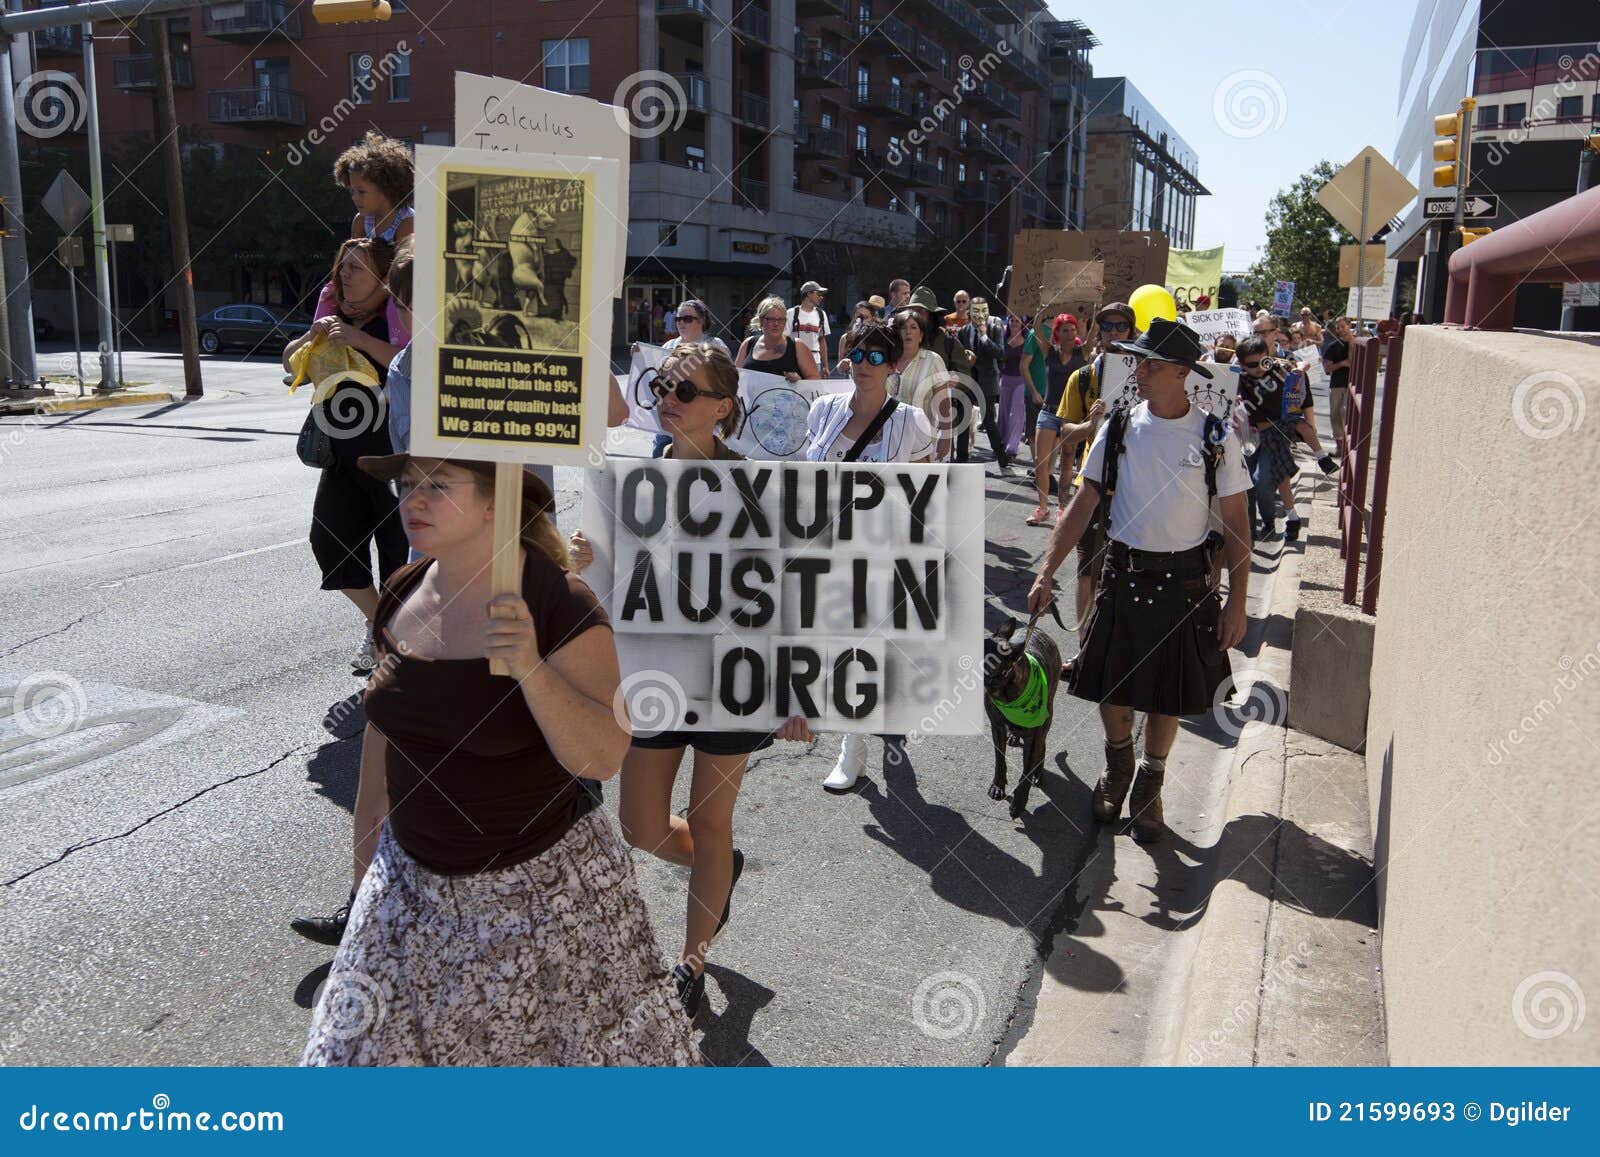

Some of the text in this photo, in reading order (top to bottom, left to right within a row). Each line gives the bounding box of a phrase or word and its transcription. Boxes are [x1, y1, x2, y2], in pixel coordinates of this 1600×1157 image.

[483, 95, 575, 139] Calculus
[1431, 203, 1451, 212] ONE
[1192, 313, 1212, 324] SICK
[452, 356, 568, 376] In America the 1% are
[444, 374, 578, 394] more equal than the 99%
[440, 393, 458, 407] We
[459, 396, 486, 410] want
[487, 399, 505, 411] our
[506, 400, 550, 415] equality
[442, 416, 577, 439] We are the 99%!
[621, 467, 940, 544] OCXUPY
[620, 550, 939, 631] AUSTIN
